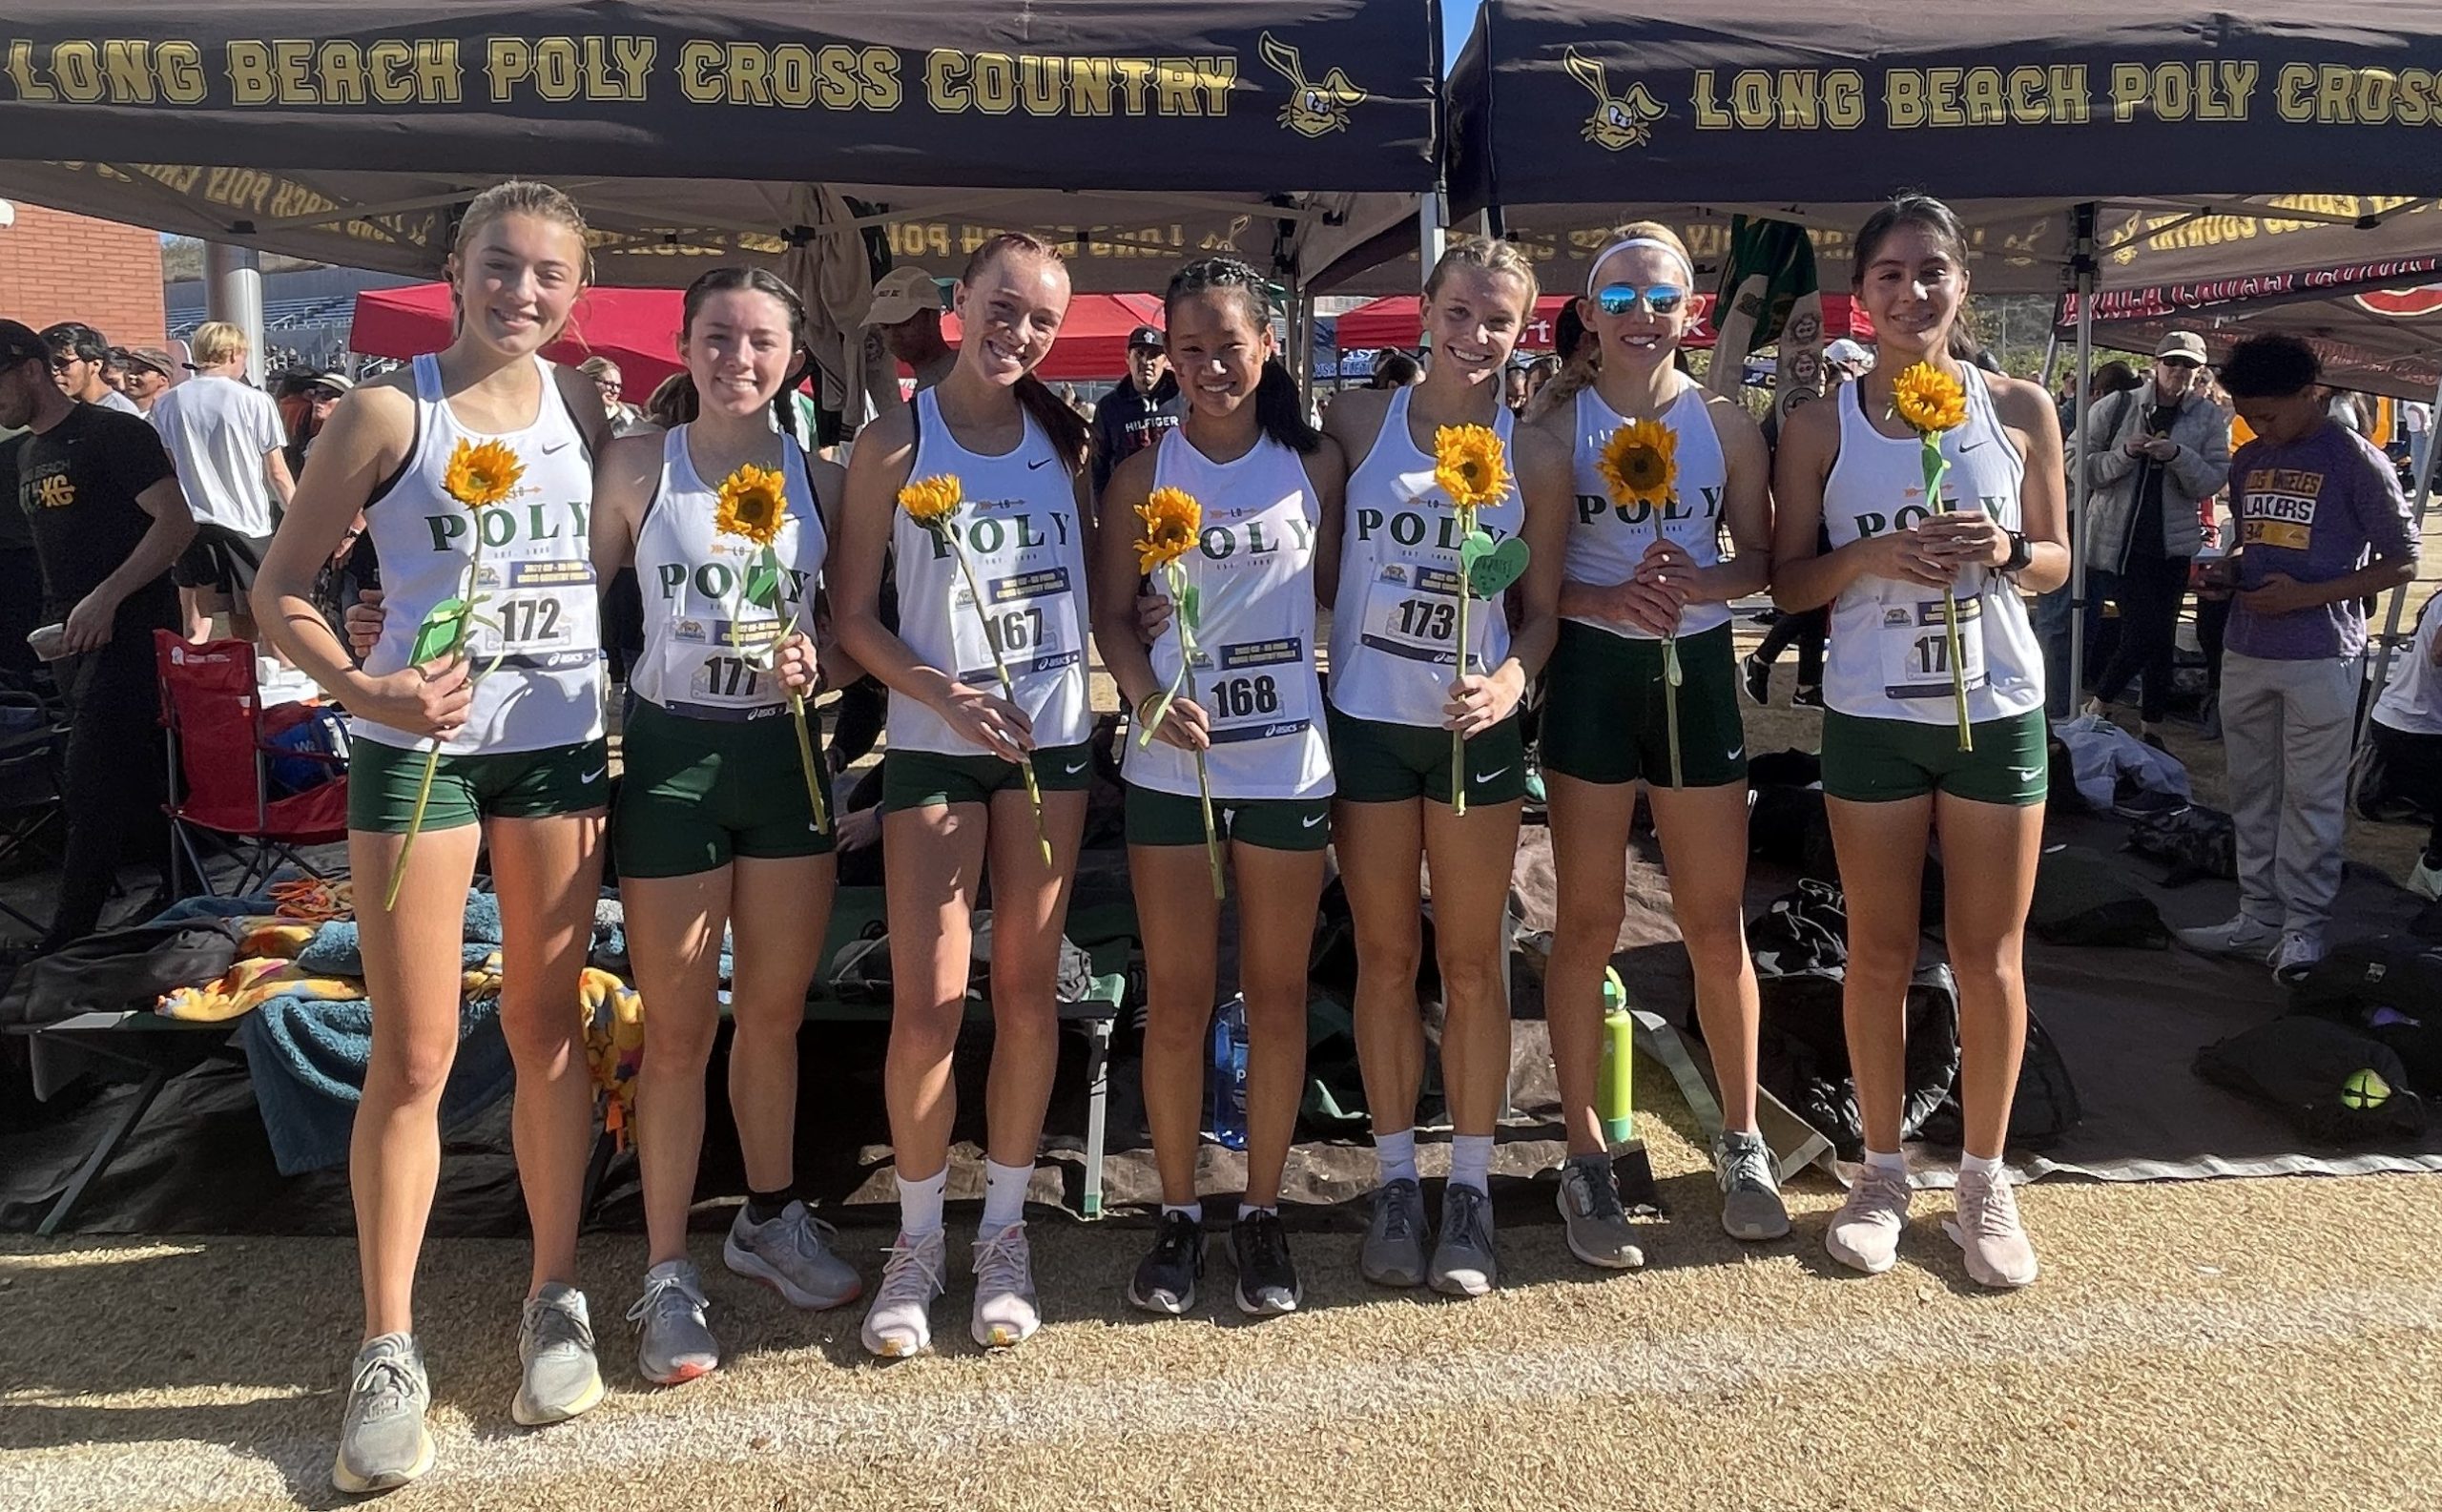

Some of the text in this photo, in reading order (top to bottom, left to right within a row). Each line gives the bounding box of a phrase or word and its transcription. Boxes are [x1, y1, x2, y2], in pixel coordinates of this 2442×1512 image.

[4, 35, 1238, 116] LONG BEACH POLY CROSS COUNTRY
[1689, 61, 2442, 131] LONG BEACH POLY CROS
[1125, 416, 1179, 432] HILFIGER
[424, 501, 590, 551] POLY
[1853, 496, 2006, 538] POY
[2245, 496, 2312, 521] LAKERS
[1199, 519, 1313, 560] OLY
[497, 597, 561, 642] 172
[983, 608, 1044, 652] 167
[1398, 599, 1456, 640] 173
[1210, 674, 1278, 718] 168
